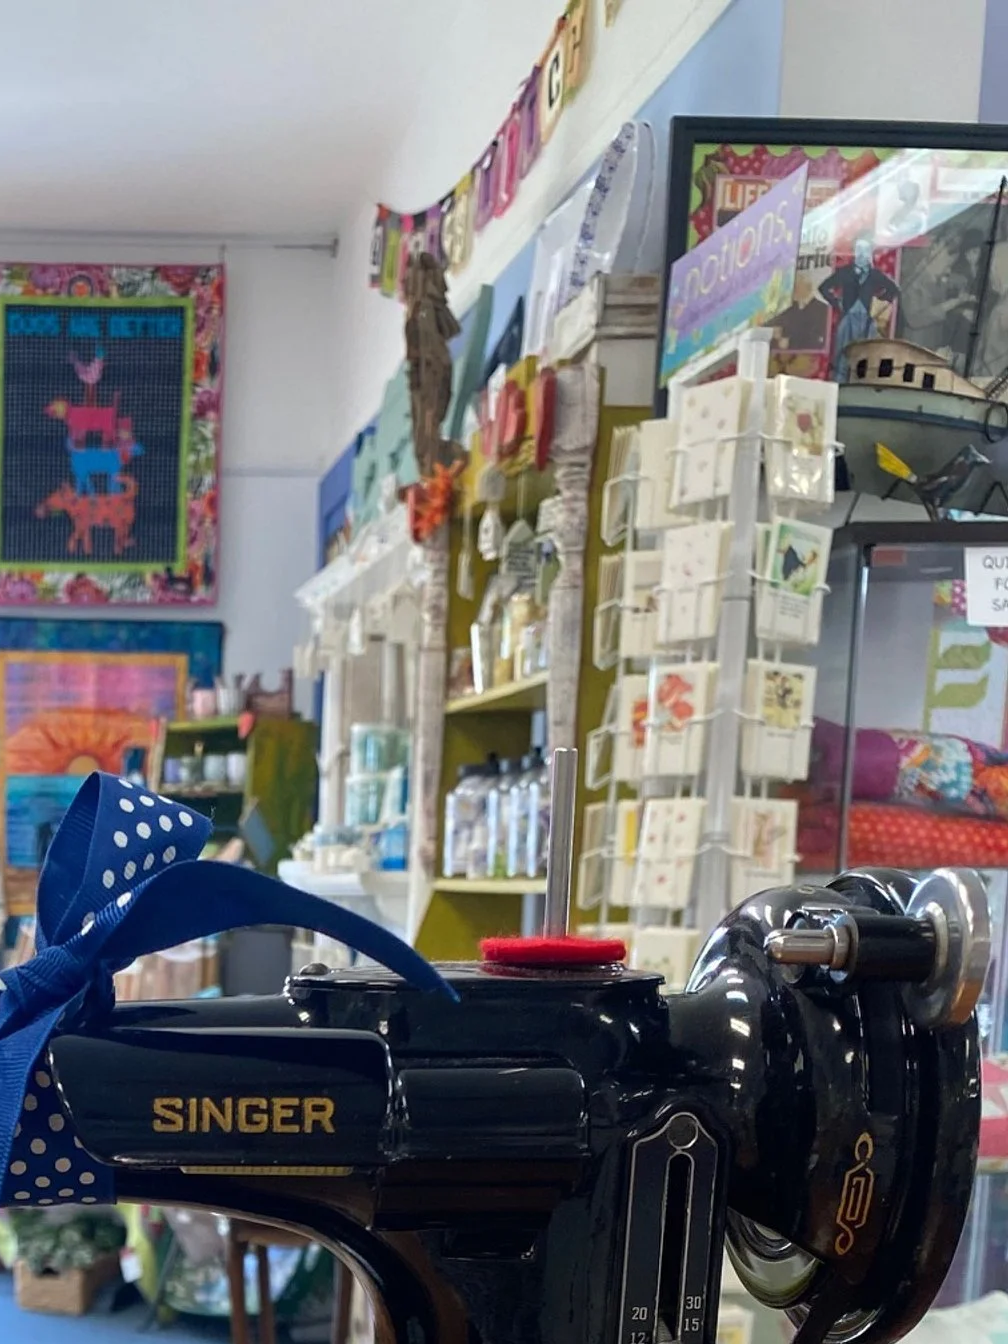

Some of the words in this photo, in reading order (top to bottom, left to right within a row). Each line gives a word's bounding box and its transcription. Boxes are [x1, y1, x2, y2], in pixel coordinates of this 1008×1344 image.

[152, 1097, 335, 1133] SINGER
[632, 1306, 648, 1320] 20
[686, 1296, 702, 1310] 30
[684, 1318, 700, 1332] 15
